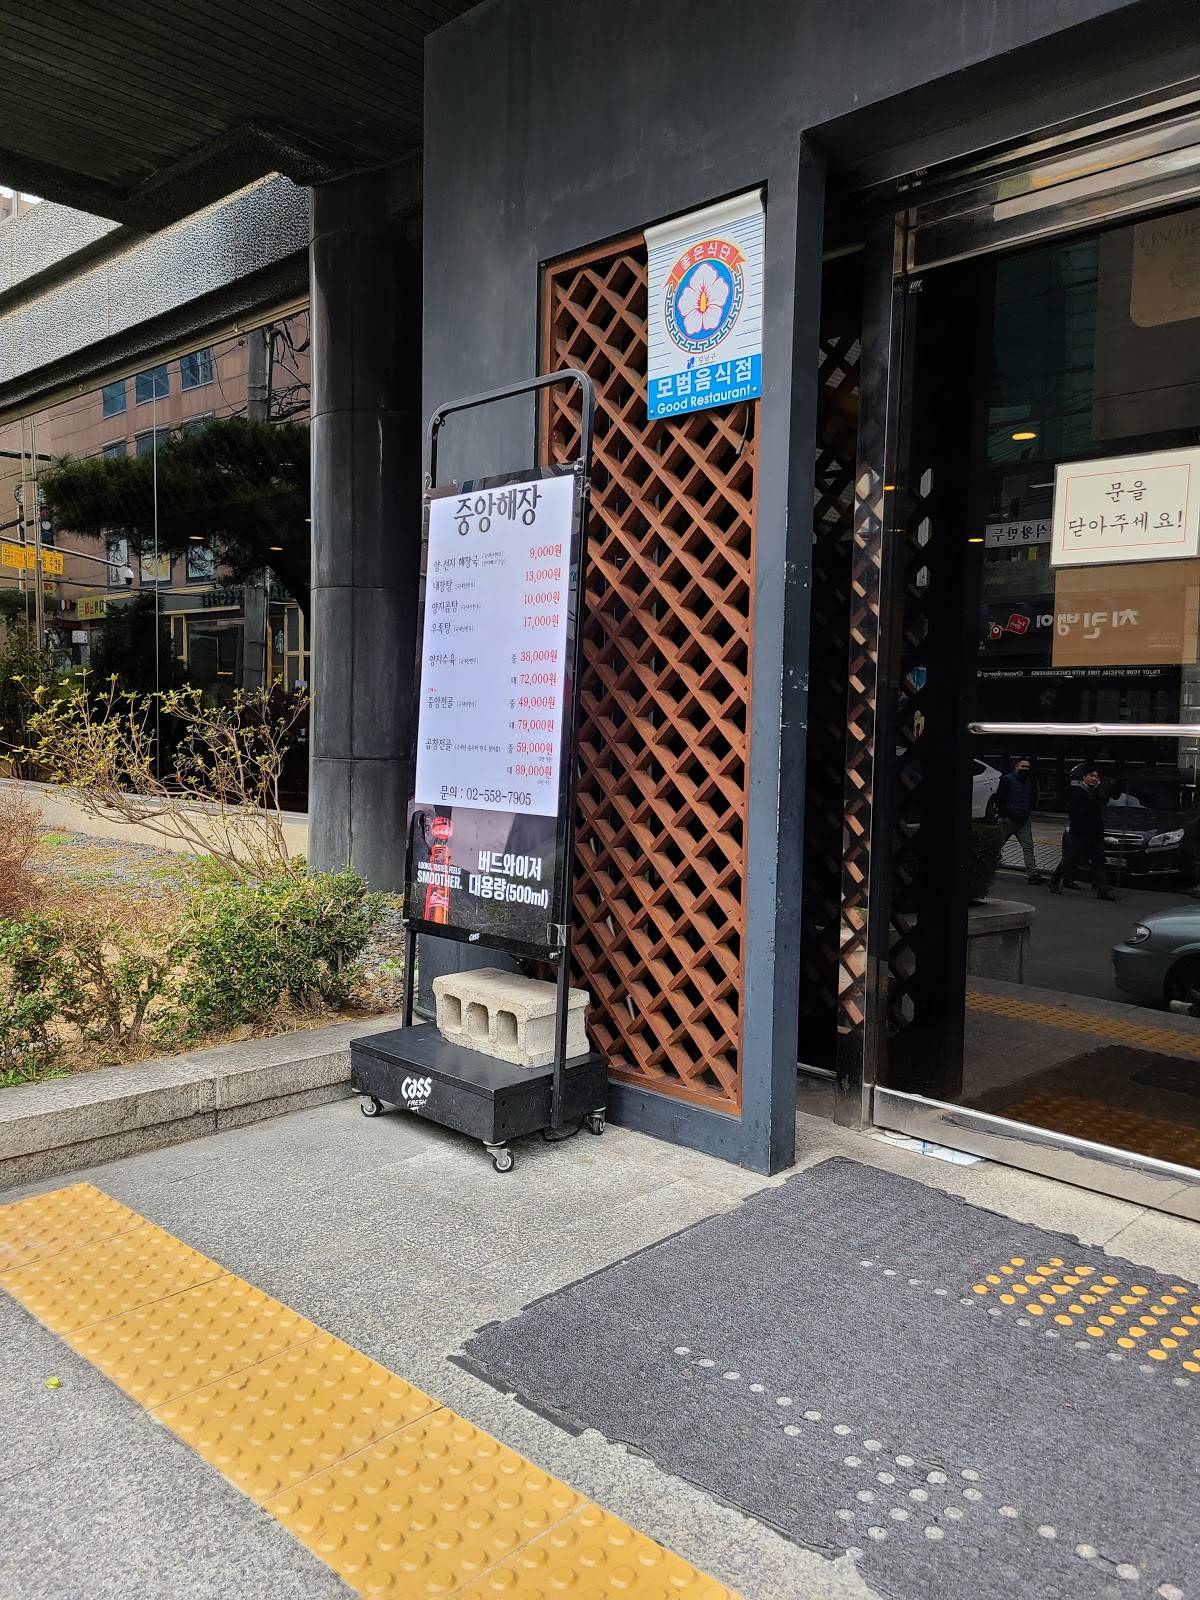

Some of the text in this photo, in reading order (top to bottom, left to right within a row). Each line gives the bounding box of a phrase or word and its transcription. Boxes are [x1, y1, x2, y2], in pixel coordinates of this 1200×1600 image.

[680, 242, 732, 271] 좋은식단
[656, 356, 752, 400] 모범음식점
[657, 384, 750, 414] Good Restaurant
[1105, 480, 1148, 503] 문을
[454, 484, 542, 536] 중앙해장
[1068, 510, 1184, 538] 닫아주세요!
[530, 544, 562, 559] 9,000원
[525, 568, 561, 582] 13,000원
[432, 600, 458, 614] 양지곰탕
[524, 592, 560, 606] 10,000원
[524, 614, 560, 628] 17,000원
[520, 650, 558, 663] 38,000원
[520, 672, 557, 686] 72,000원
[518, 696, 556, 710] 49,000원
[518, 719, 554, 732] 79,000원
[516, 742, 553, 756] 59,000원
[515, 764, 552, 779] 89,000원
[440, 785, 458, 801] 문의
[466, 788, 532, 806] 02-558-7905
[478, 850, 542, 882] 버드와이저
[417, 870, 462, 890] SMOOTHER.
[468, 874, 549, 909] 대용량(500ml)
[407, 1098, 427, 1106] FRESH
